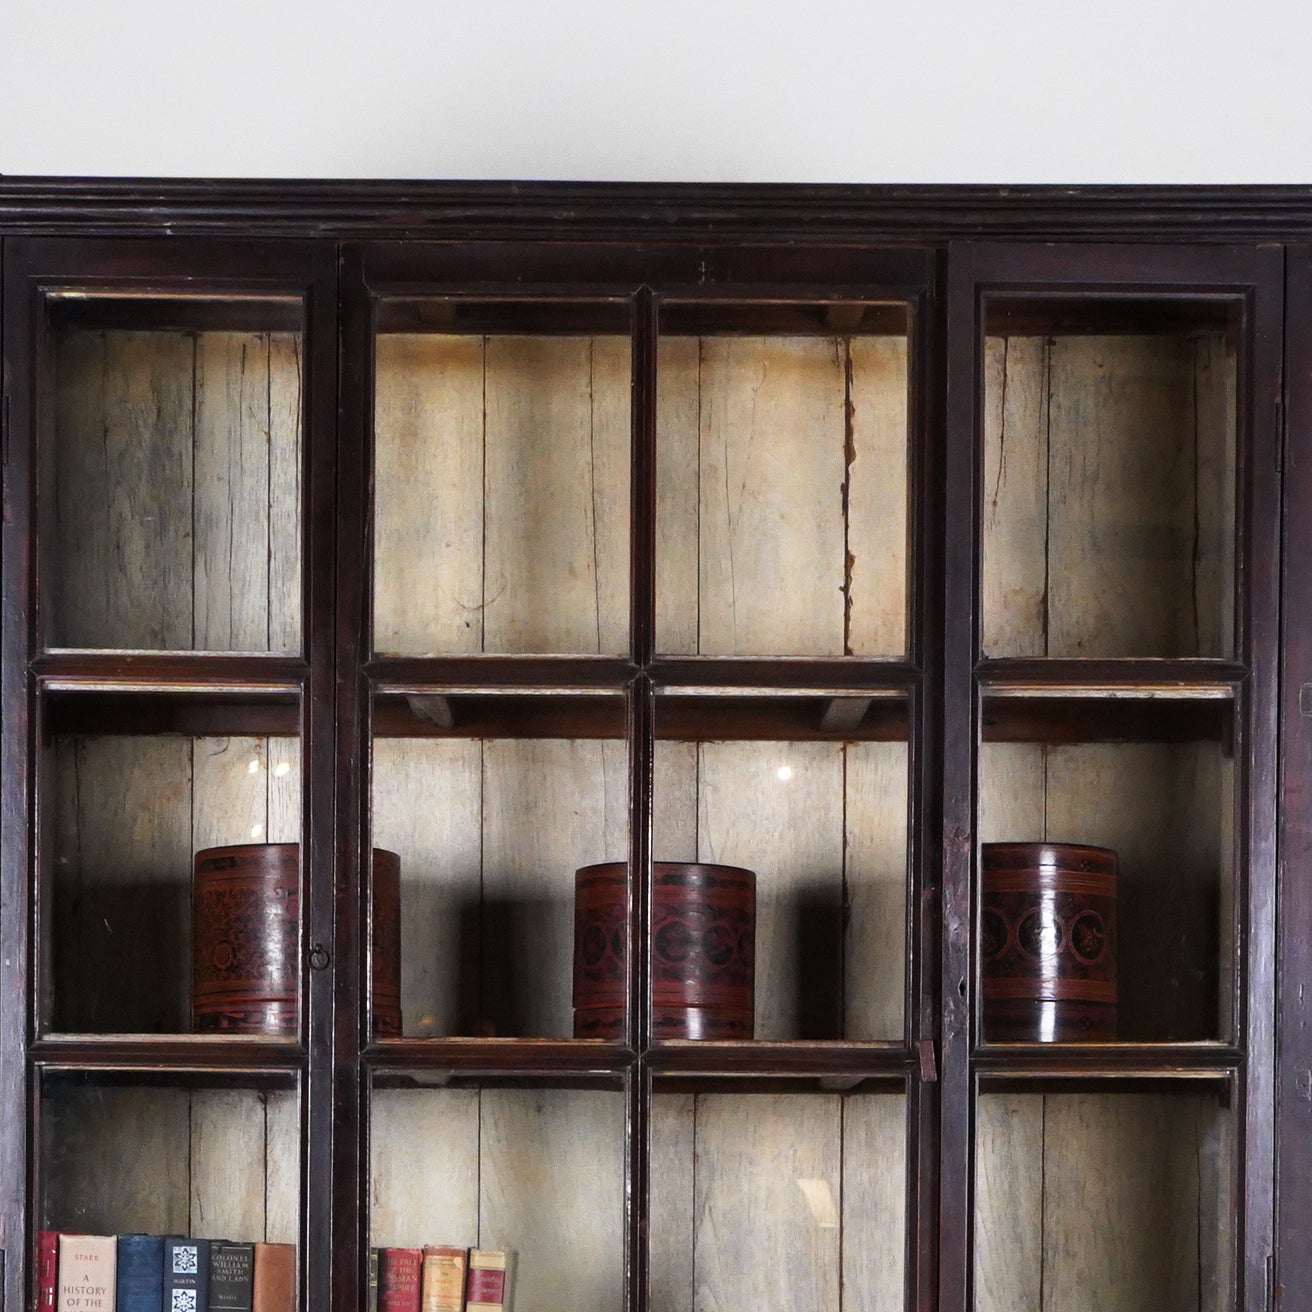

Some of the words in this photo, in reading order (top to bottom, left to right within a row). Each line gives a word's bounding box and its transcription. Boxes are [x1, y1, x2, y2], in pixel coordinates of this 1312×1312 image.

[82, 1274, 90, 1282] A
[63, 1286, 107, 1295] HISTORY
[66, 1298, 81, 1307] OF
[84, 1298, 103, 1308] THE
